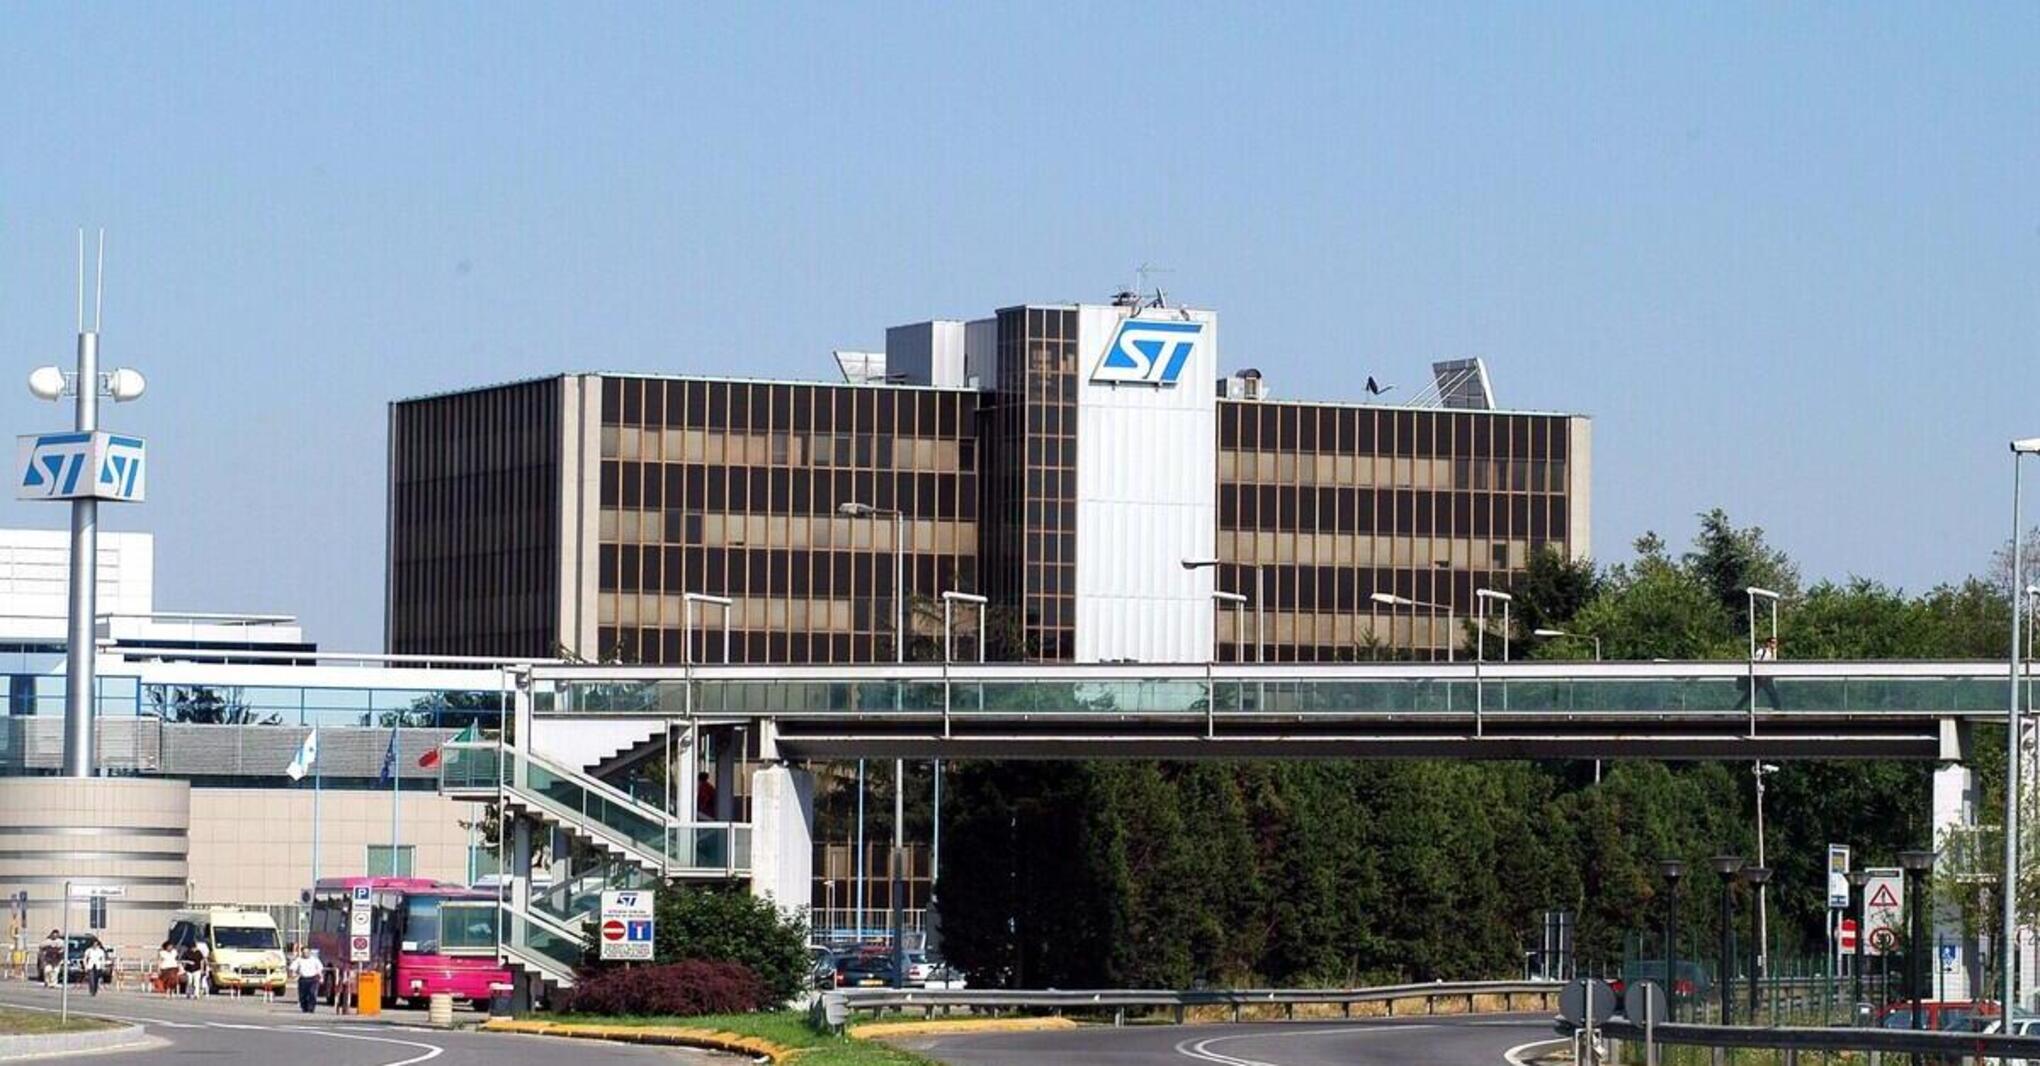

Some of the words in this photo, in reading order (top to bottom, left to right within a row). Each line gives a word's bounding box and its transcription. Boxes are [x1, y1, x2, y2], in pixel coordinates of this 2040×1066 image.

[1097, 320, 1204, 382] ST
[23, 434, 92, 495] ST
[100, 436, 143, 497] ST
[616, 892, 638, 907] ST
